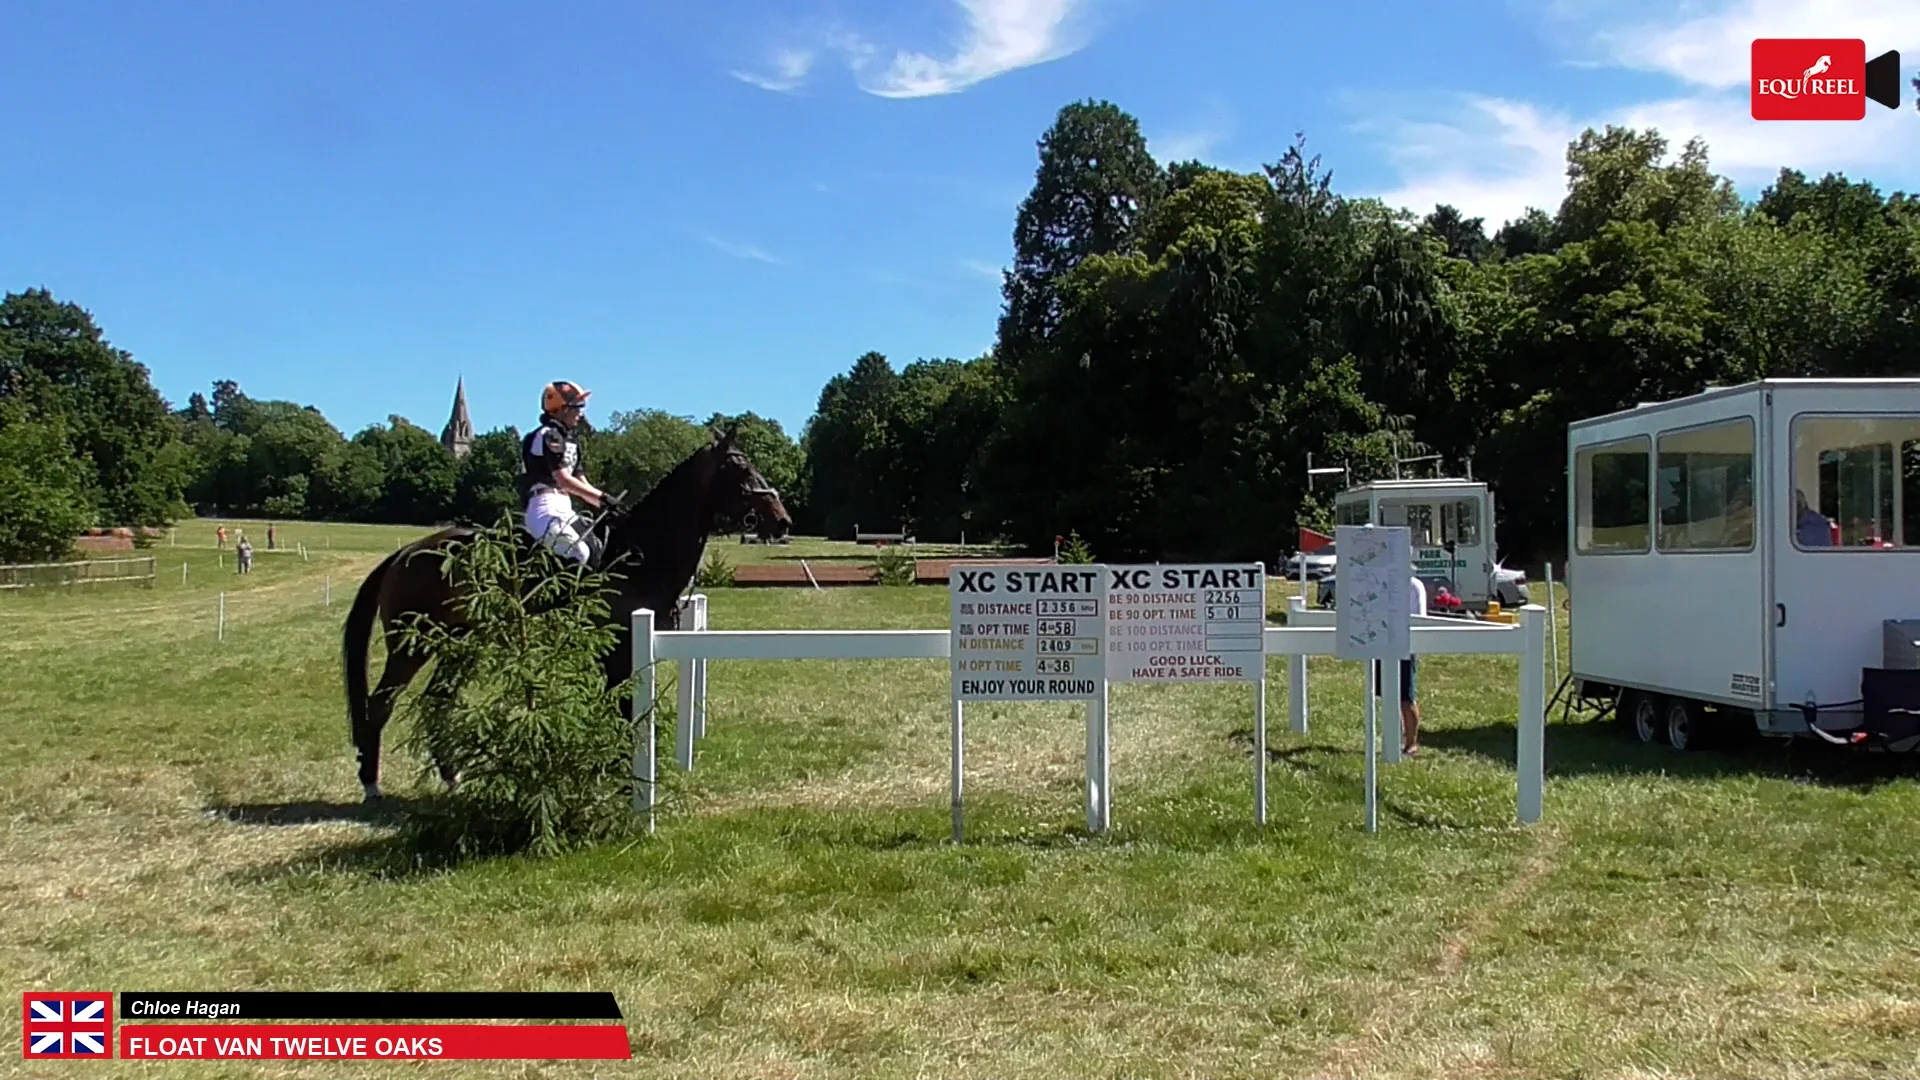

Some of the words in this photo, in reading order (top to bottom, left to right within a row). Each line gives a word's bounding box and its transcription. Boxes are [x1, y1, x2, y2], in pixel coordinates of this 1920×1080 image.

[958, 571, 996, 593] XC
[1006, 571, 1097, 593] START
[1110, 569, 1151, 590] XC
[1162, 569, 1261, 589] START
[1109, 594, 1123, 604] BE
[1126, 594, 1140, 604] 90
[1143, 593, 1197, 604] DISTANCE
[1205, 591, 1240, 604] 2256
[977, 603, 1033, 615] DISTANCE
[1040, 602, 1076, 613] 2356
[1109, 610, 1123, 620] BE
[1126, 610, 1140, 620] 90
[1170, 609, 1197, 620] TIME
[977, 624, 999, 636] OPT
[1002, 623, 1030, 635] TIME
[1109, 626, 1122, 636] BE
[1127, 626, 1146, 636] 100
[1149, 625, 1203, 636] DISTANCE
[959, 639, 967, 650] N
[970, 639, 1025, 650] DISTANCE
[1040, 640, 1072, 651] 2409
[1109, 642, 1122, 652] BE
[1127, 642, 1146, 652] 100
[1176, 641, 1203, 652] TIME
[958, 660, 967, 671] N
[970, 660, 993, 672] OPT
[995, 660, 1022, 672] TIME
[1149, 656, 1186, 666] GOOD
[1132, 667, 1165, 678] HAVE
[1168, 667, 1177, 678] A
[1180, 667, 1211, 678] SAFE
[1214, 667, 1243, 677] RIDE
[962, 680, 1006, 694] ENJOY
[1009, 680, 1046, 694] YOUR
[1049, 680, 1095, 694] ROUND
